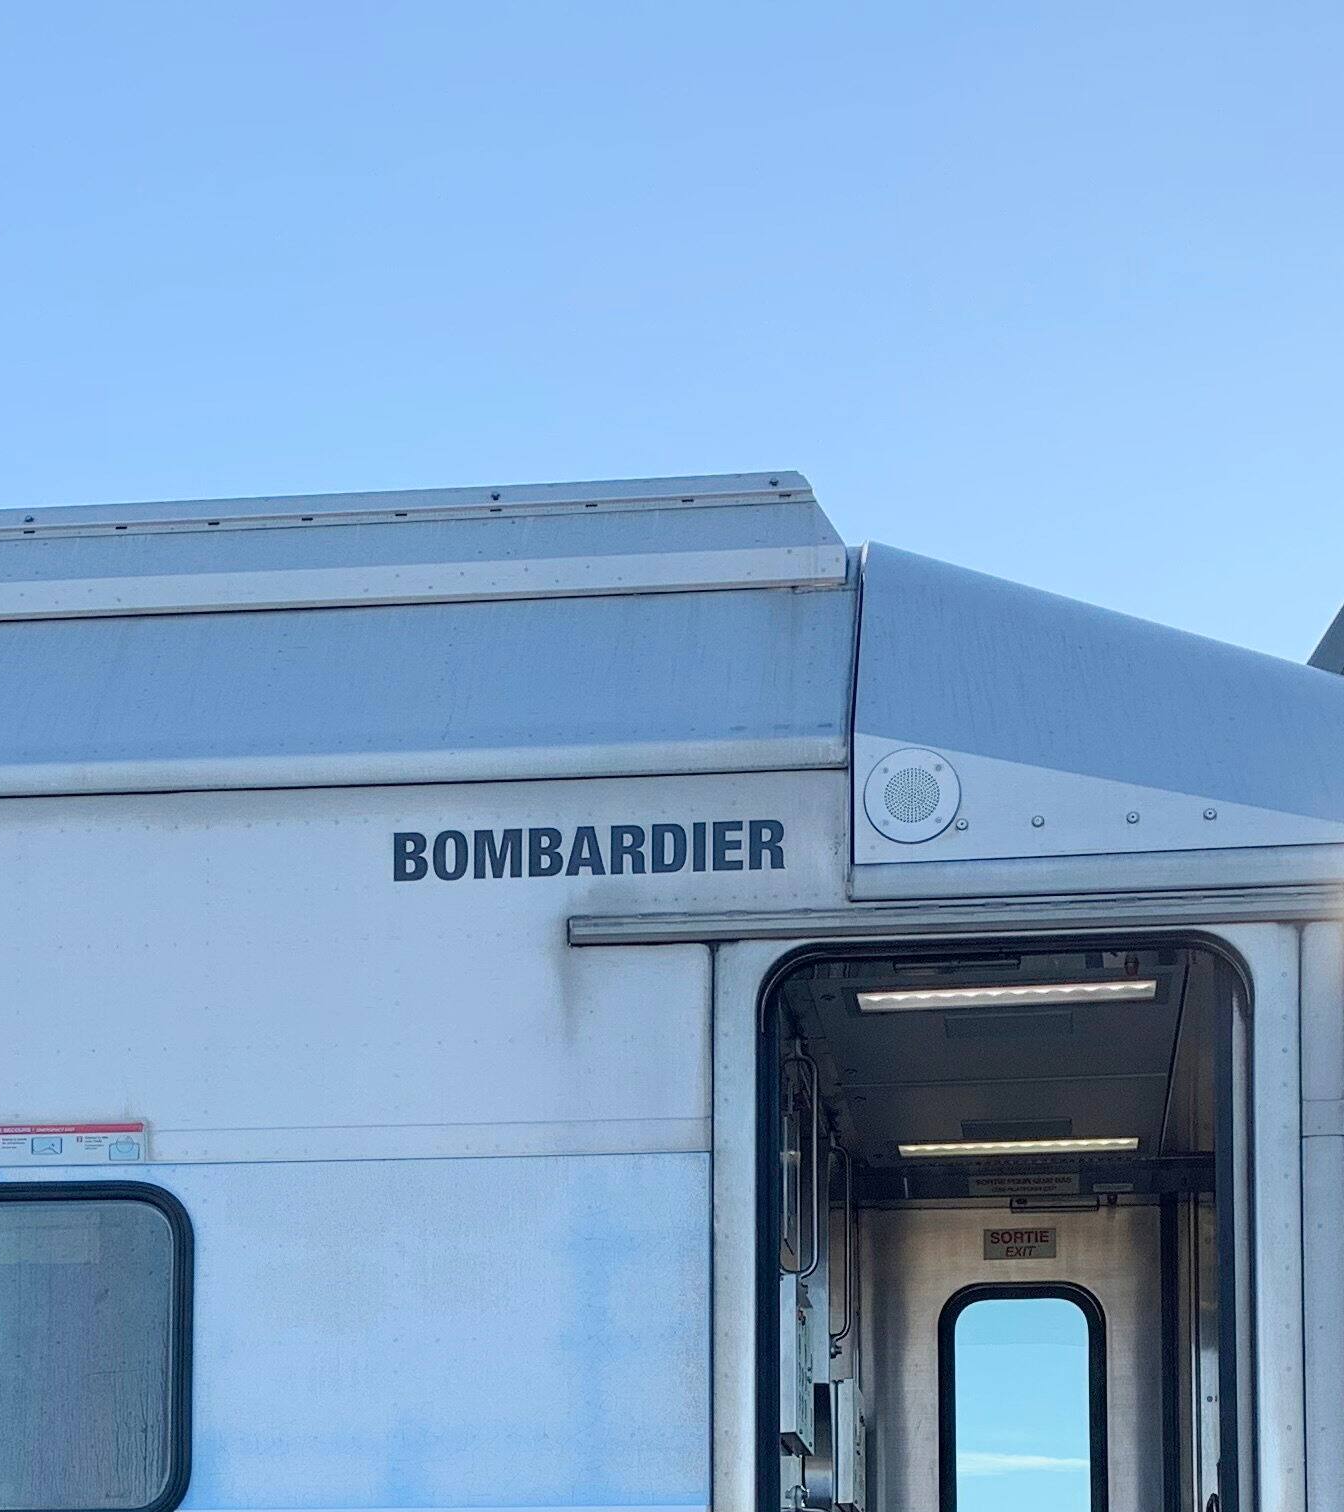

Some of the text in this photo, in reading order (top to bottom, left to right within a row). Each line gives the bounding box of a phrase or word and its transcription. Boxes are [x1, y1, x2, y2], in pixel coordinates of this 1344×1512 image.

[393, 819, 786, 882] BOMBARDIER
[990, 1231, 1049, 1244] SORTIE
[1005, 1246, 1036, 1257] EXIT
